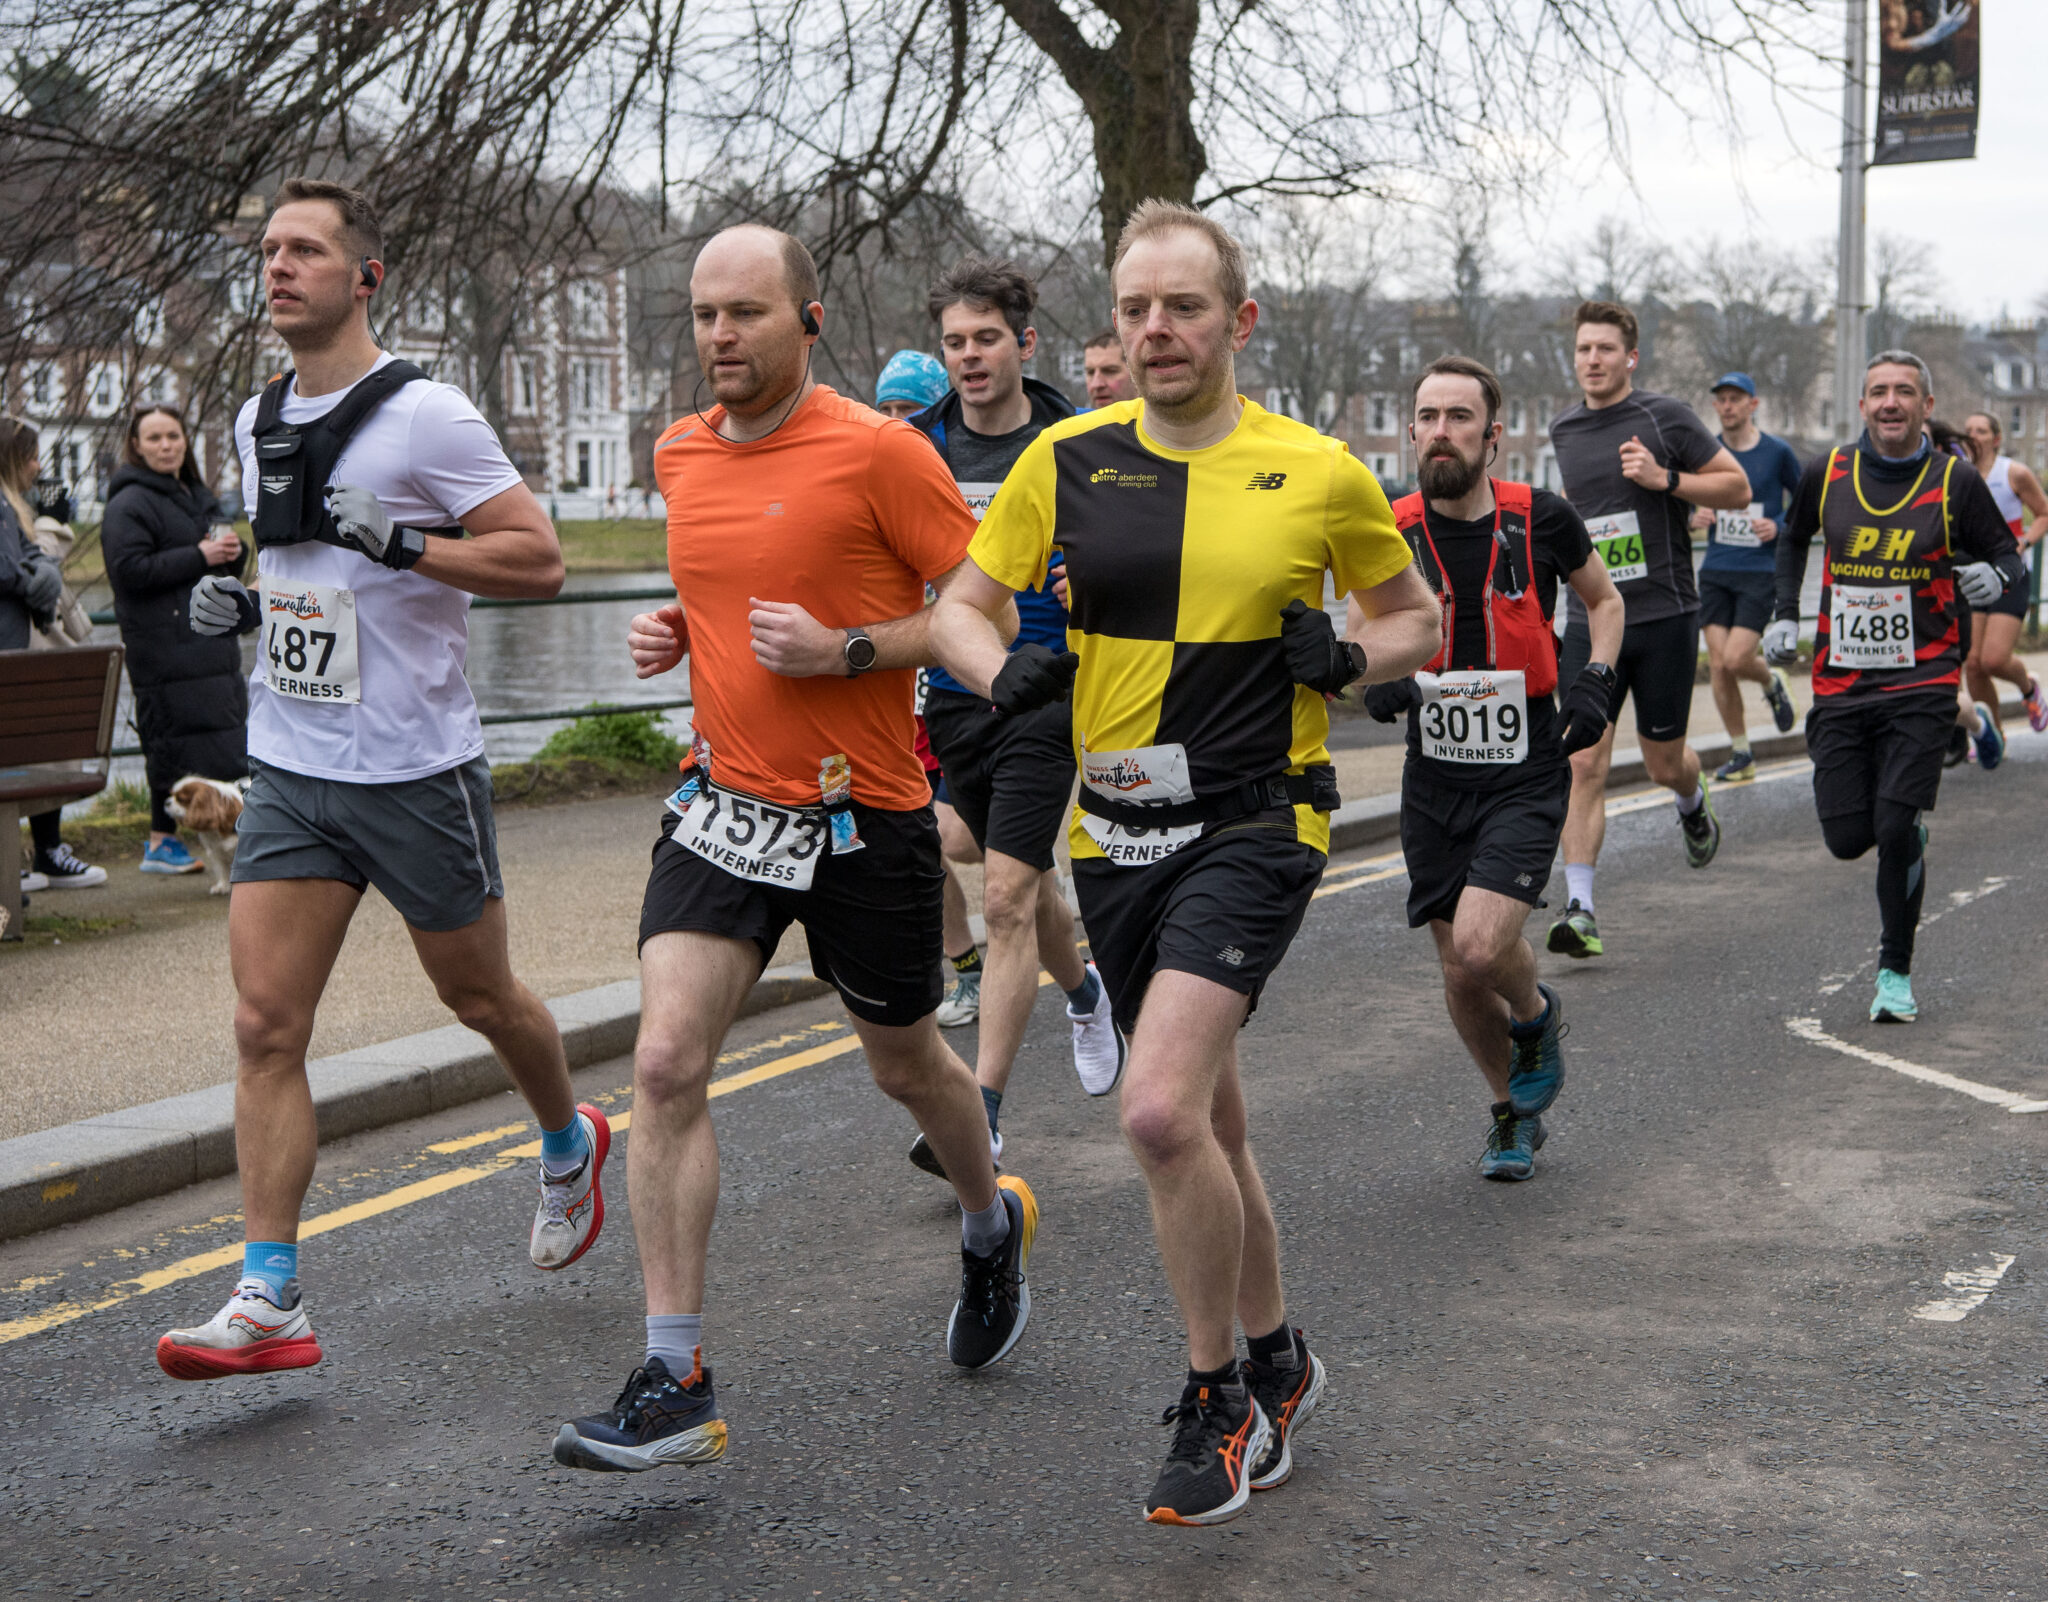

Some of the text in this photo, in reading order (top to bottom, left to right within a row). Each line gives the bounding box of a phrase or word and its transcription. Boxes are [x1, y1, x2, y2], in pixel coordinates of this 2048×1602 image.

[1881, 88, 1975, 114] SUPERSTAR
[1118, 473, 1158, 482] aberdeen
[1720, 517, 1753, 536] 162
[1595, 537, 1641, 567] 66
[1889, 566, 1931, 581] CLUB
[1835, 613, 1910, 642] 1488
[269, 622, 336, 677] 487
[1839, 645, 1903, 656] INVERNESS
[1425, 701, 1521, 743] 3019
[1434, 744, 1515, 760] INVERNESS
[700, 791, 822, 861] 1573
[690, 836, 797, 882] INVERNESS
